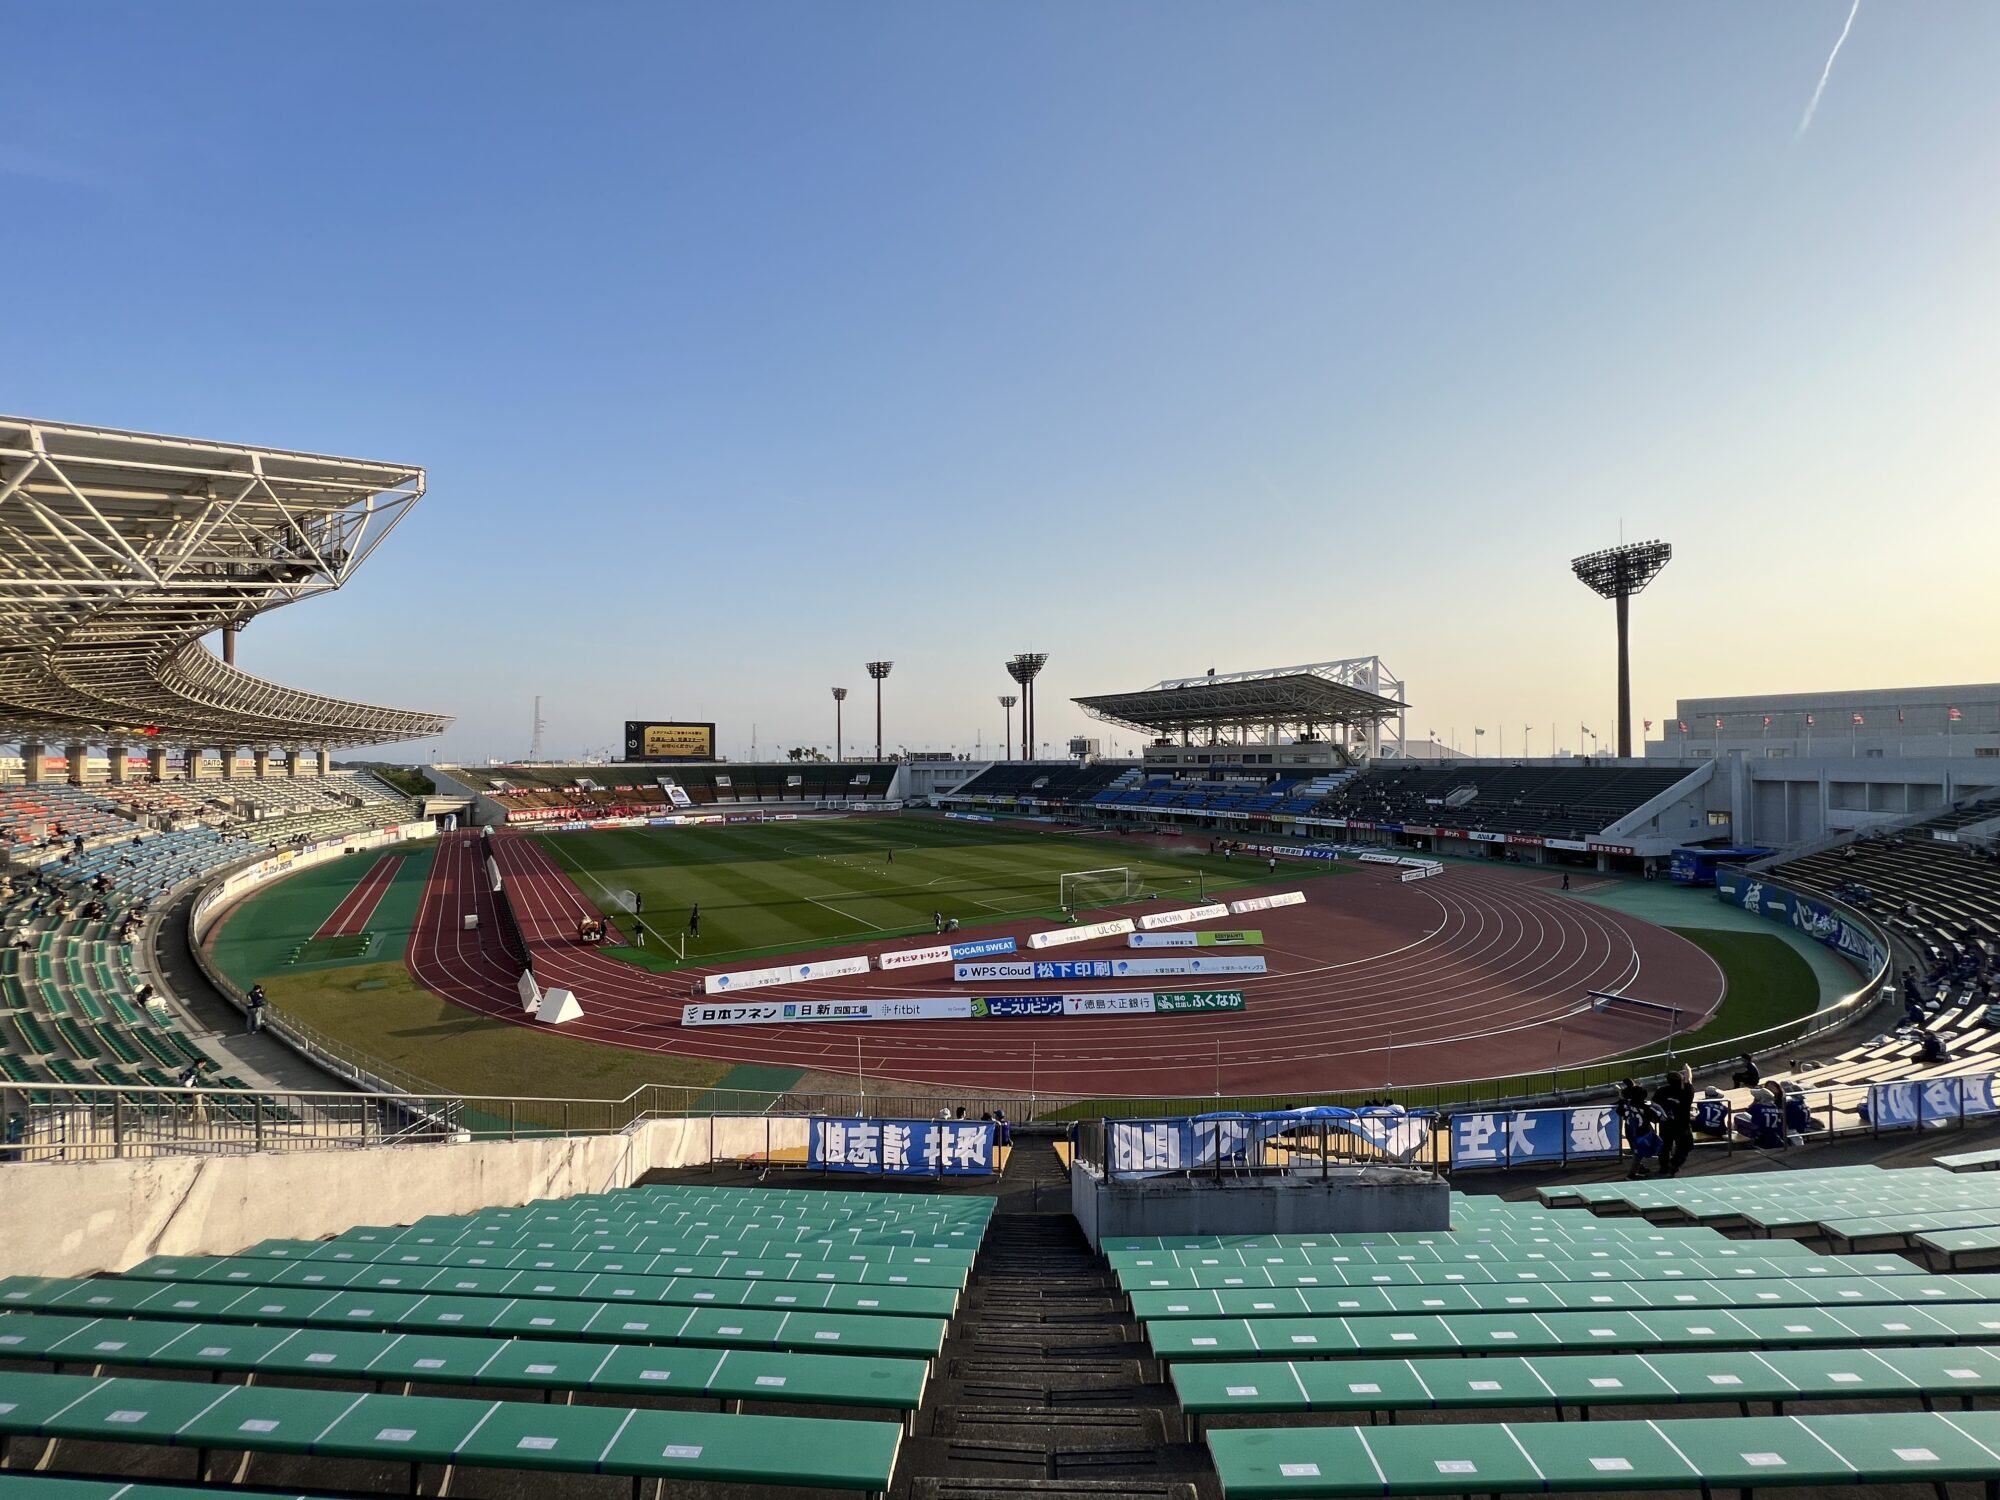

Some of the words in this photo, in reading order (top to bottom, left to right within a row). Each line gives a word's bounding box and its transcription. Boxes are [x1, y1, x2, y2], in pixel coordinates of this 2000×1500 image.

[953, 946, 984, 956] POCARI
[985, 941, 1013, 951] SWEAT
[971, 967, 997, 976] WPS
[999, 966, 1031, 976] Cloud
[1037, 961, 1111, 978] 松下印刷
[758, 976, 781, 984] 大塚化学
[1084, 997, 1150, 1010] 徳島大正銀行
[1192, 993, 1242, 1007] ふくなが
[702, 1007, 777, 1020] 日本フネン
[801, 1004, 831, 1015] 日新
[834, 1004, 868, 1014] 四国工場
[894, 1004, 921, 1015] fitbit
[990, 1001, 1062, 1015] ピースリビング
[1704, 1106, 1722, 1123] 12
